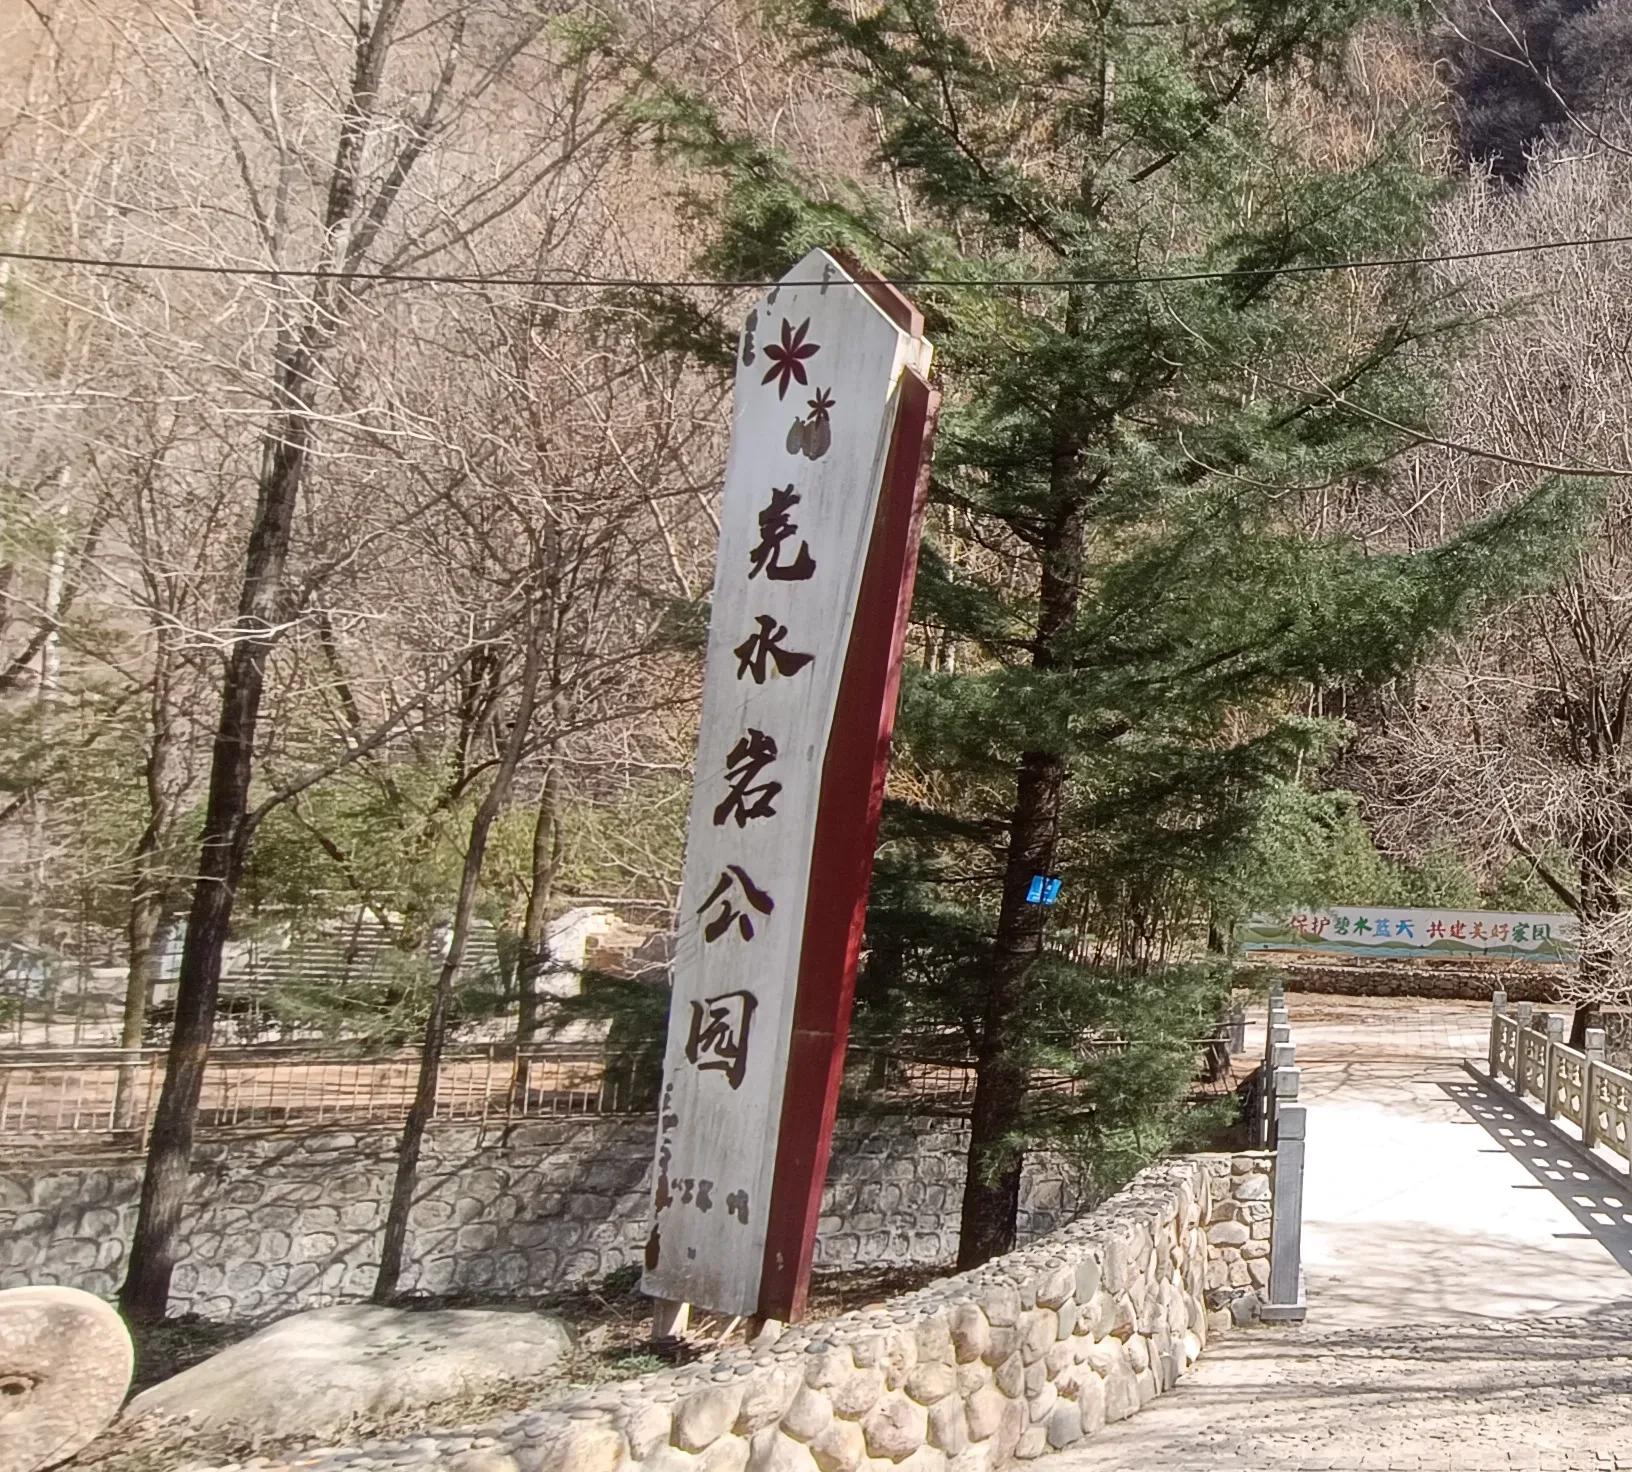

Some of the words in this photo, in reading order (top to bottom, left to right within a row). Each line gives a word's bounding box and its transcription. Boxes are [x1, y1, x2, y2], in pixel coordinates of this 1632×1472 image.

[1289, 914, 1415, 938] 保护碧水蓝天
[1427, 919, 1551, 943] 共建美好家园
